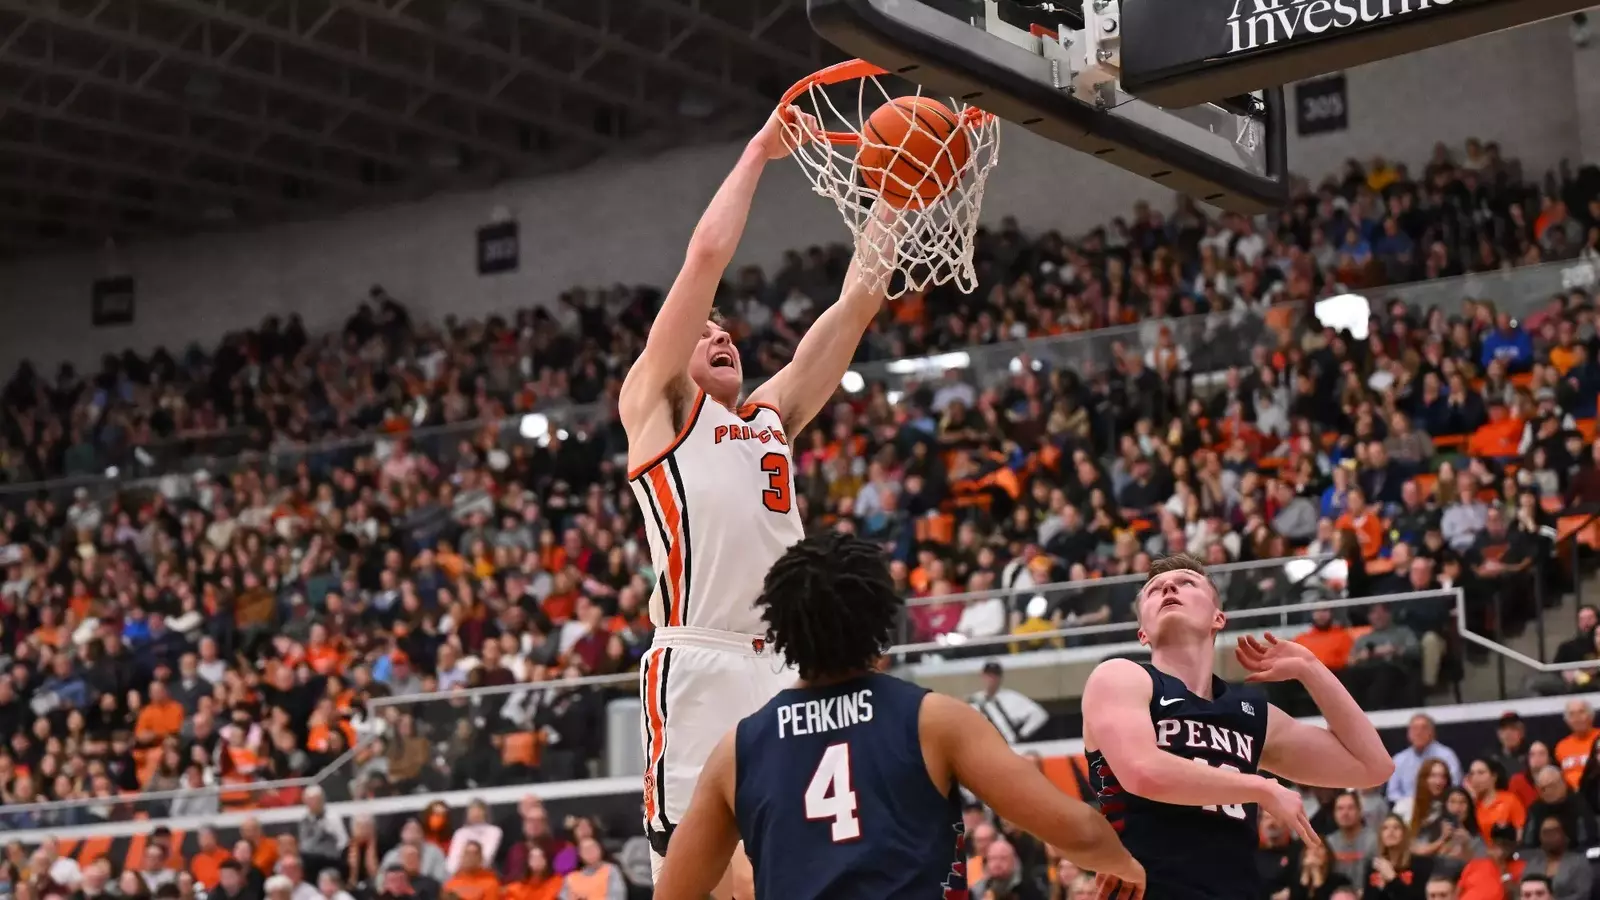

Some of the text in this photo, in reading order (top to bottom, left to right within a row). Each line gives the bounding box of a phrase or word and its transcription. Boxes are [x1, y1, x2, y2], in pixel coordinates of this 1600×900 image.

[760, 452, 792, 515] 3
[777, 689, 873, 739] PERKINS
[1156, 718, 1254, 763] PENN
[803, 741, 862, 843] 4
